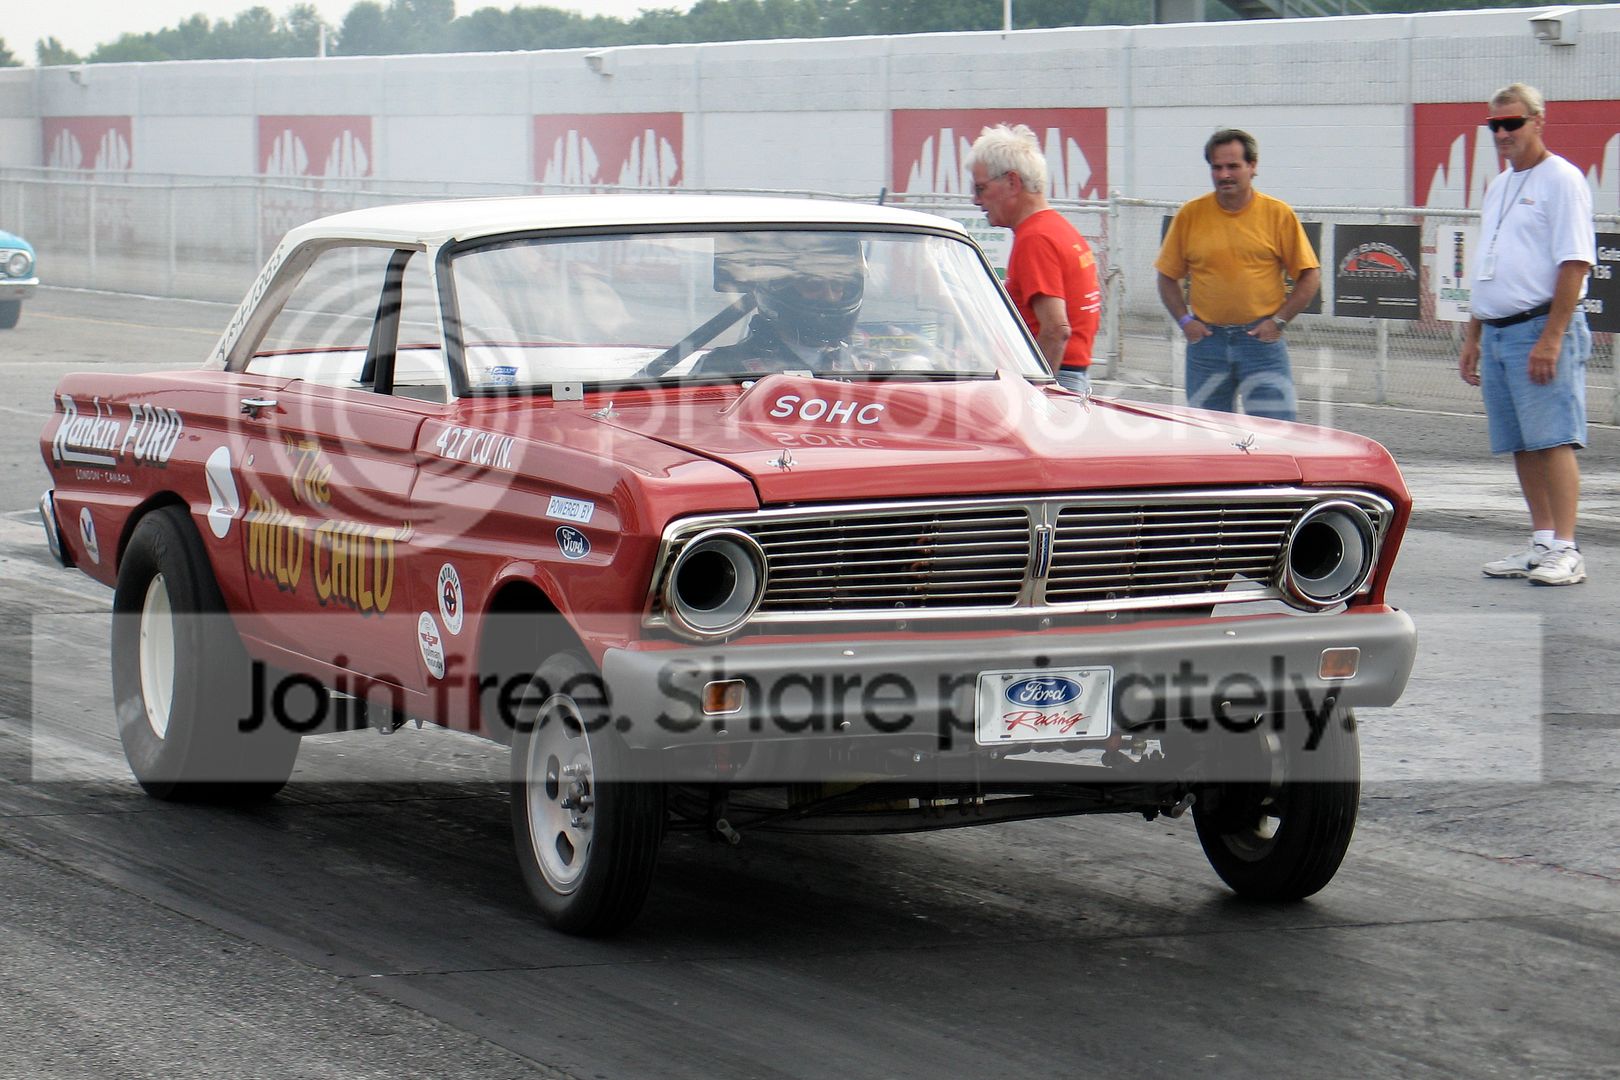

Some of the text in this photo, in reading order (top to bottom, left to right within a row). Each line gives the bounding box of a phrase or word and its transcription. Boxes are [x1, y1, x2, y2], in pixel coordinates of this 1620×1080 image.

[769, 395, 885, 425] SOHC
[52, 393, 184, 463] Rankin FORD
[436, 426, 473, 460] 427
[550, 499, 592, 519] POWERED BY
[246, 489, 307, 588] WILD
[562, 528, 585, 555] Ford
[1019, 680, 1066, 702] Ford
[1002, 710, 1091, 734] Racing
